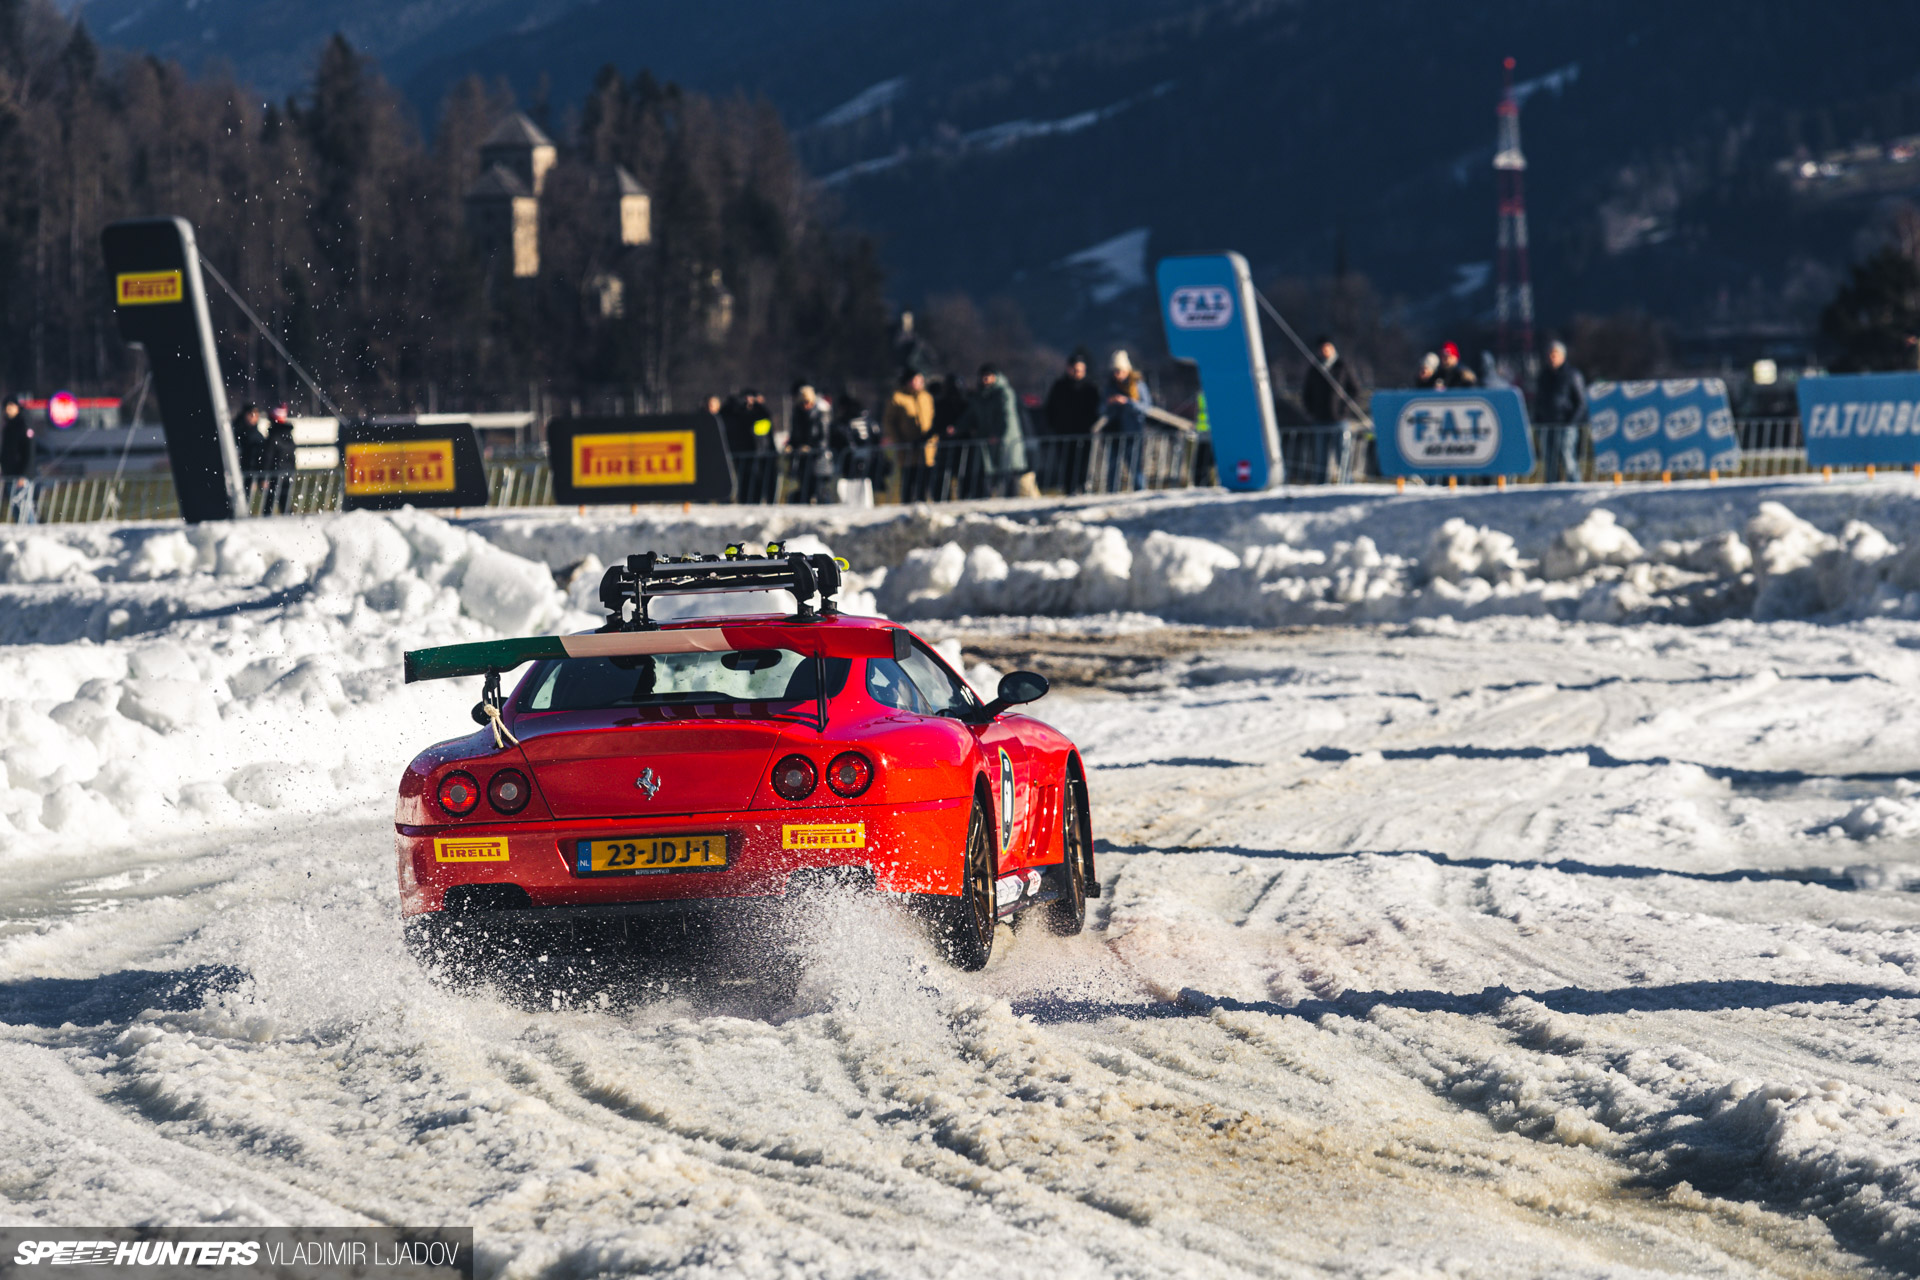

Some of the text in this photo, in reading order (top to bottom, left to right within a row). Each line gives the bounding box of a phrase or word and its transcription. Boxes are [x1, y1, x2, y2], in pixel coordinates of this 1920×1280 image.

[348, 450, 443, 485] PIRELLI
[581, 441, 684, 476] PIRELLI
[786, 828, 857, 844] PIRELLI
[440, 842, 501, 858] PIRELLI
[607, 840, 710, 867] 23-JDJ-1
